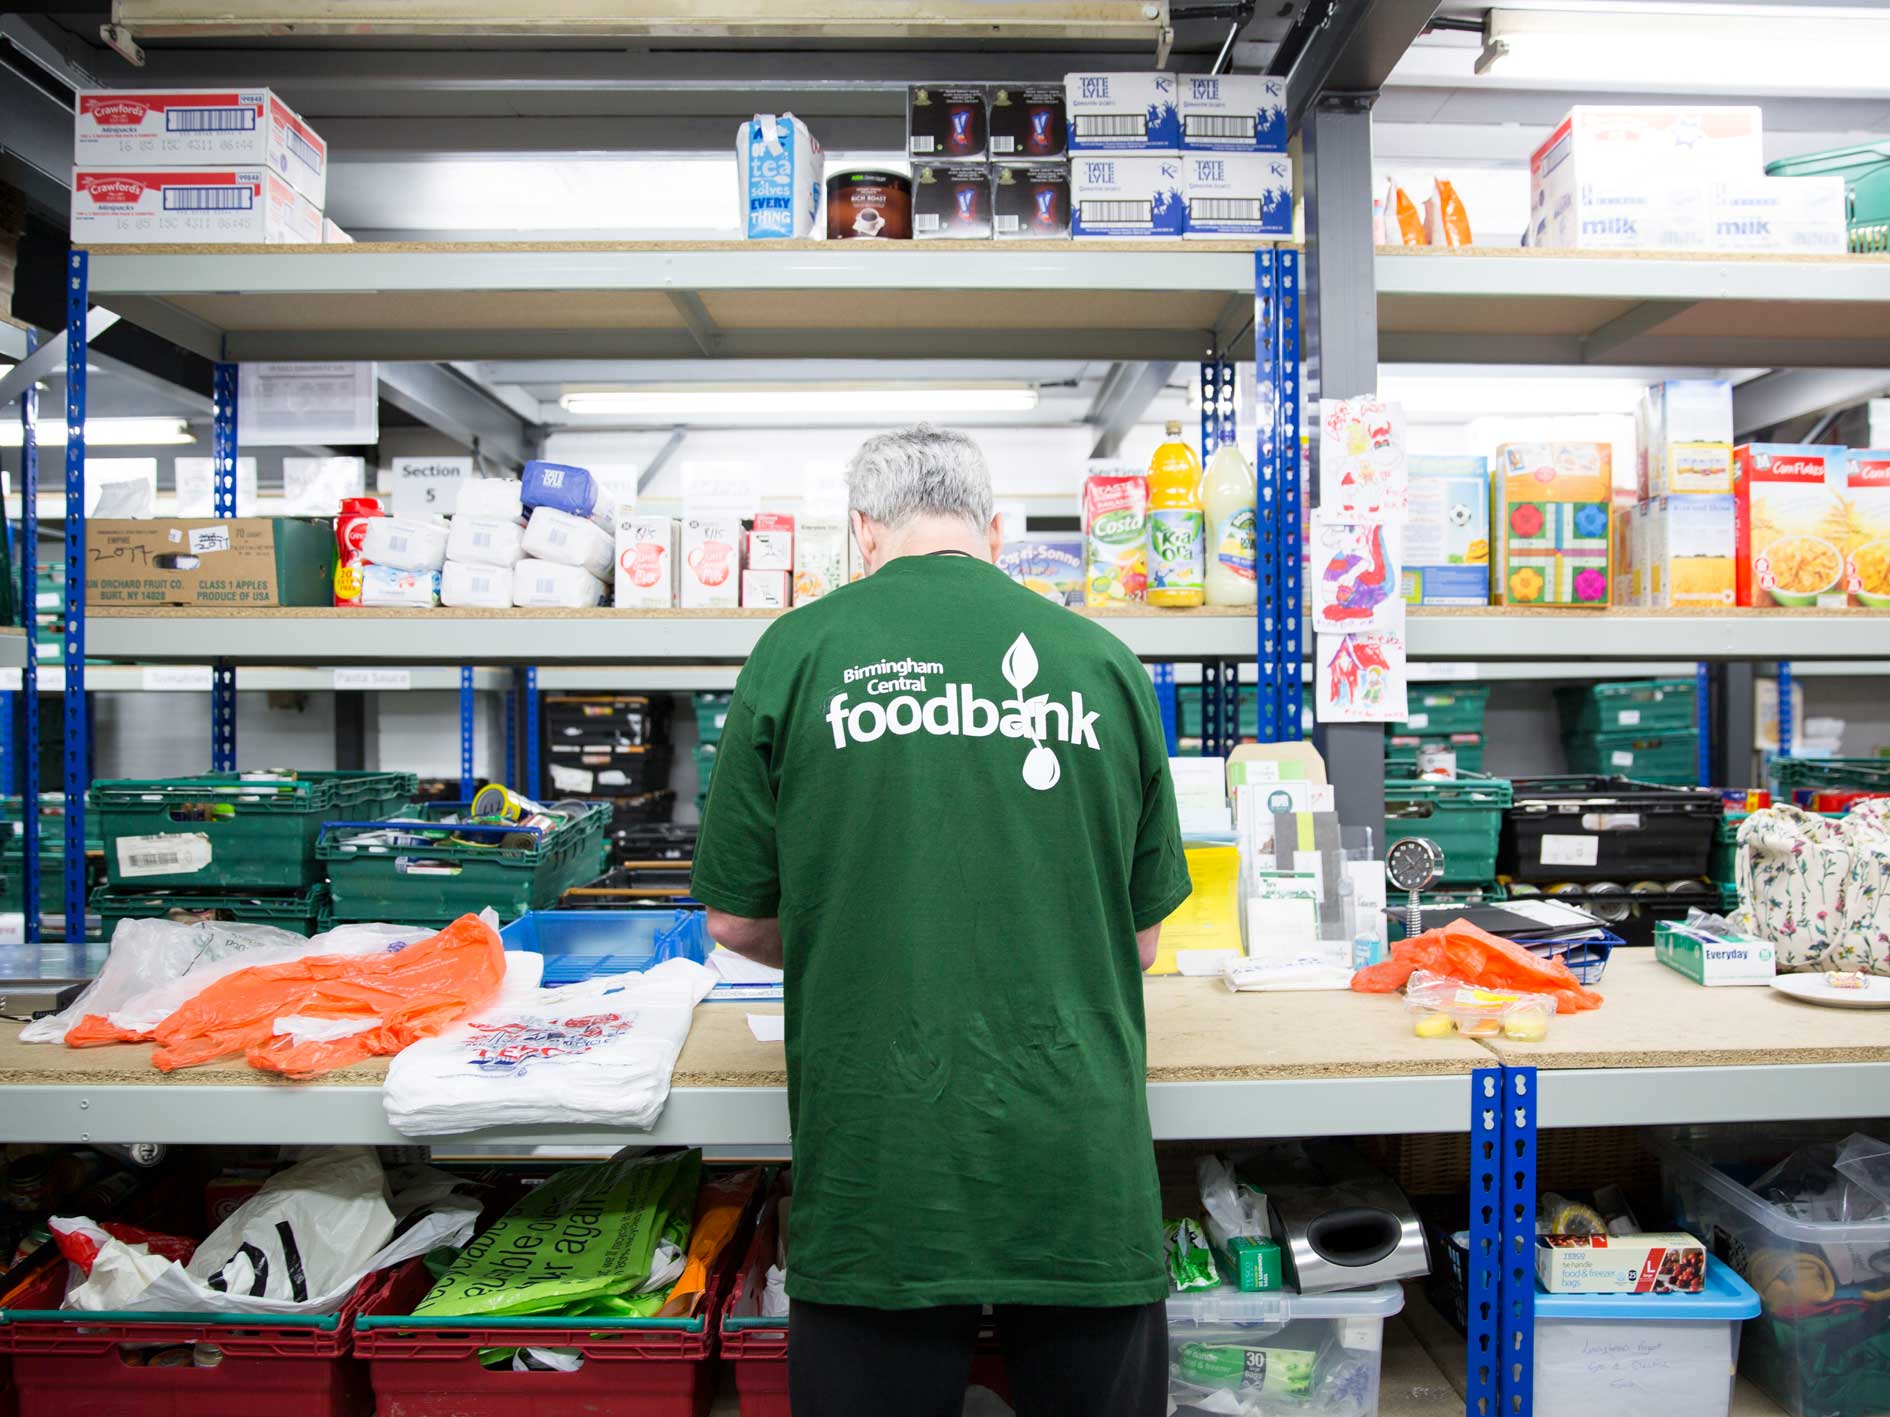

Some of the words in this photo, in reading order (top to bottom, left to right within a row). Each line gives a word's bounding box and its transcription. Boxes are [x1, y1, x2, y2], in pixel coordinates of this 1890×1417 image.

[1080, 77, 1108, 87] TATE
[1190, 78, 1219, 89] TATE
[1082, 87, 1109, 98] LYLE
[1193, 89, 1219, 99] LYLE
[94, 104, 145, 117] Crawford's
[752, 159, 791, 176] tea
[1086, 162, 1114, 173] TATE
[1195, 161, 1224, 171] TATE
[1088, 173, 1114, 184] LYLE
[1198, 171, 1224, 182] LYLE
[90, 184, 141, 195] Crawford's
[752, 184, 790, 196] solves
[751, 198, 790, 210] EVERY
[751, 209, 791, 225] THING
[1582, 217, 1638, 235] milk
[1716, 218, 1771, 235] milk
[402, 464, 461, 478] Section
[426, 489, 436, 502] 5
[1094, 516, 1142, 536] Costa
[86, 580, 98, 589] UN
[101, 580, 141, 589] ORCHARD
[144, 580, 168, 589] FRUIT
[199, 580, 226, 589] CLASS
[228, 580, 233, 589] 1
[236, 580, 268, 589] APPLES
[127, 592, 139, 600] NY
[197, 592, 237, 601] PRODUCE
[239, 592, 251, 601] OF
[253, 592, 270, 601] USA
[843, 657, 944, 684] Birmingham
[867, 676, 927, 695] Central
[825, 683, 1101, 751] foodbank
[1706, 949, 1748, 960] Everyday
[1647, 1260, 1656, 1273] L
[1562, 1269, 1581, 1277] food
[1589, 1269, 1616, 1277] freezer
[1629, 1271, 1637, 1280] 25
[1561, 1278, 1580, 1288] bags
[1246, 1352, 1264, 1367] 30
